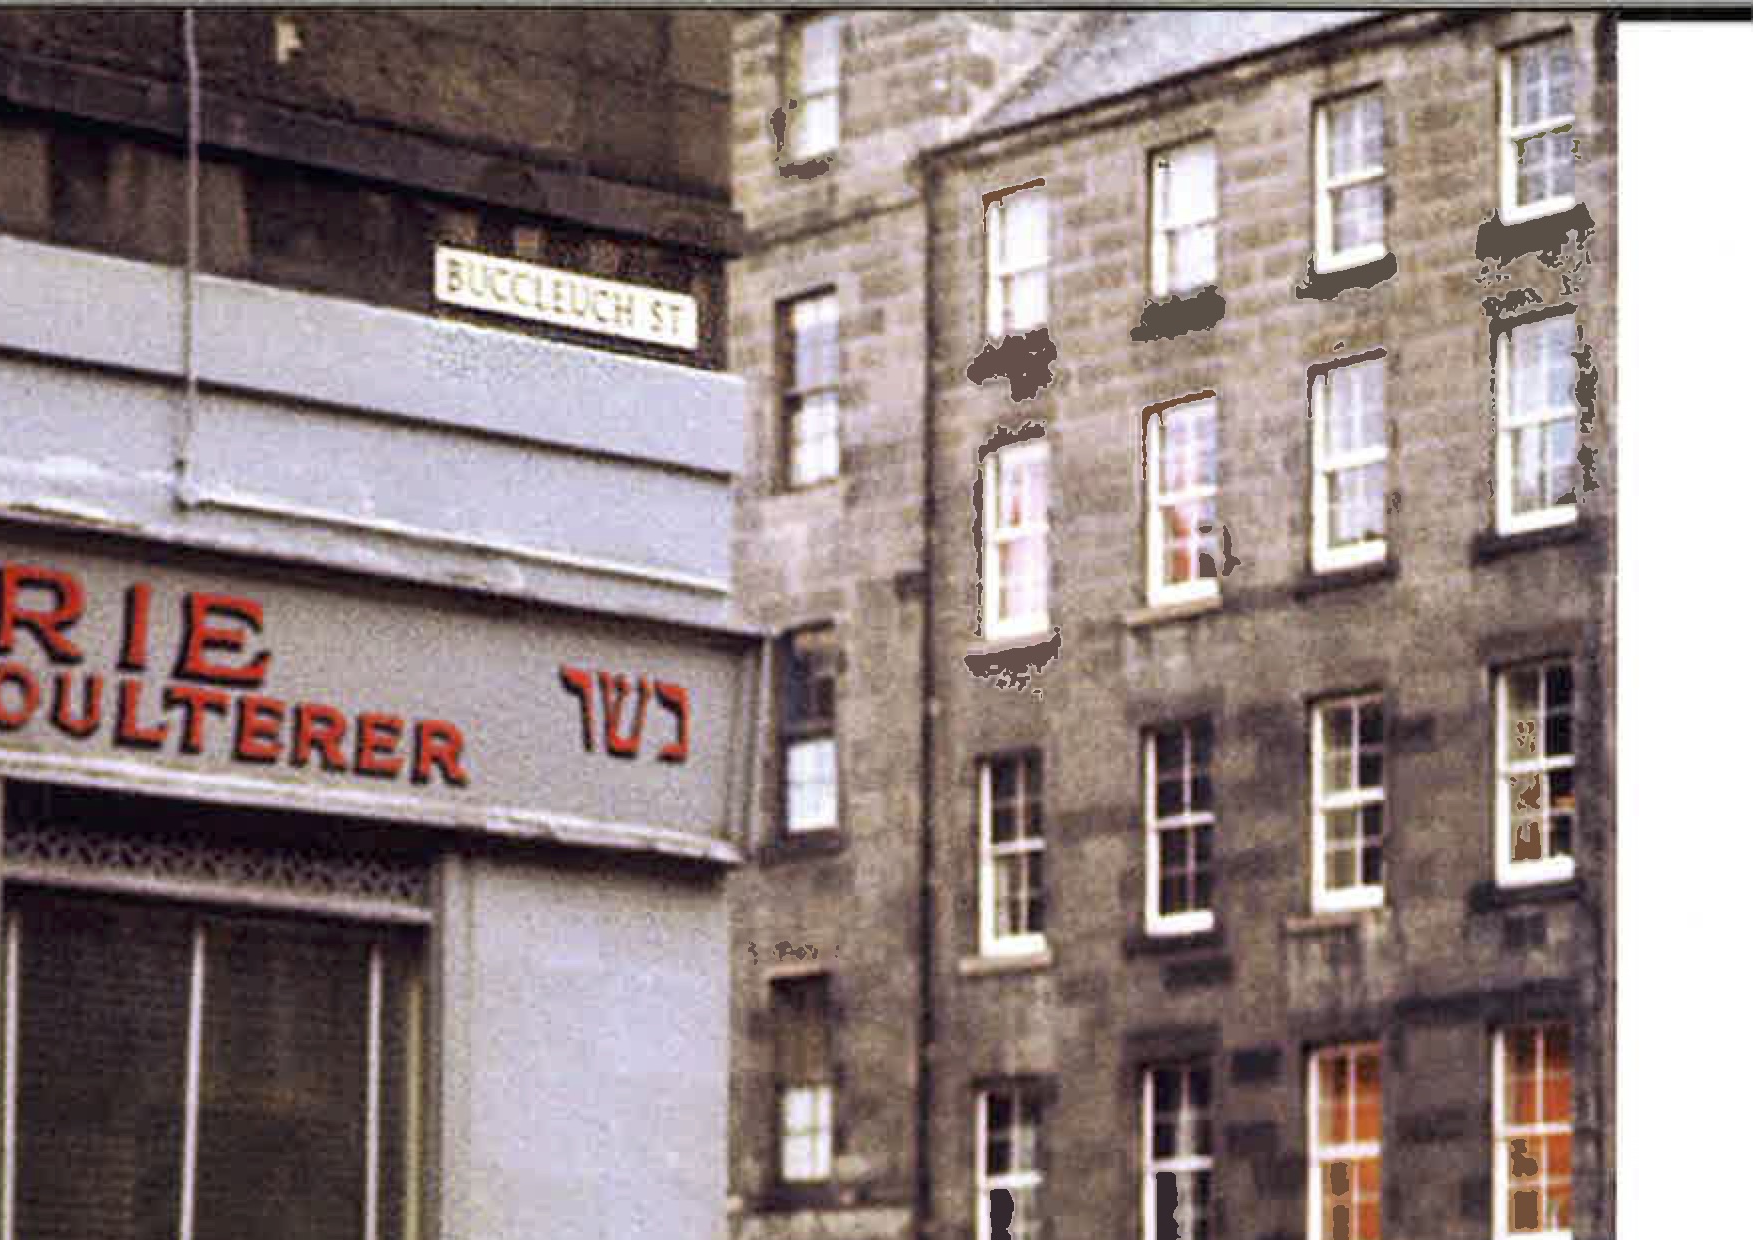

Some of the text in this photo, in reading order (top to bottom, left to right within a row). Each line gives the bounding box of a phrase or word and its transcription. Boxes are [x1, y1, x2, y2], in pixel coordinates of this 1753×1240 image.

[445, 257, 684, 336] BUCCLEUCH ST
[558, 663, 691, 765] כשר
